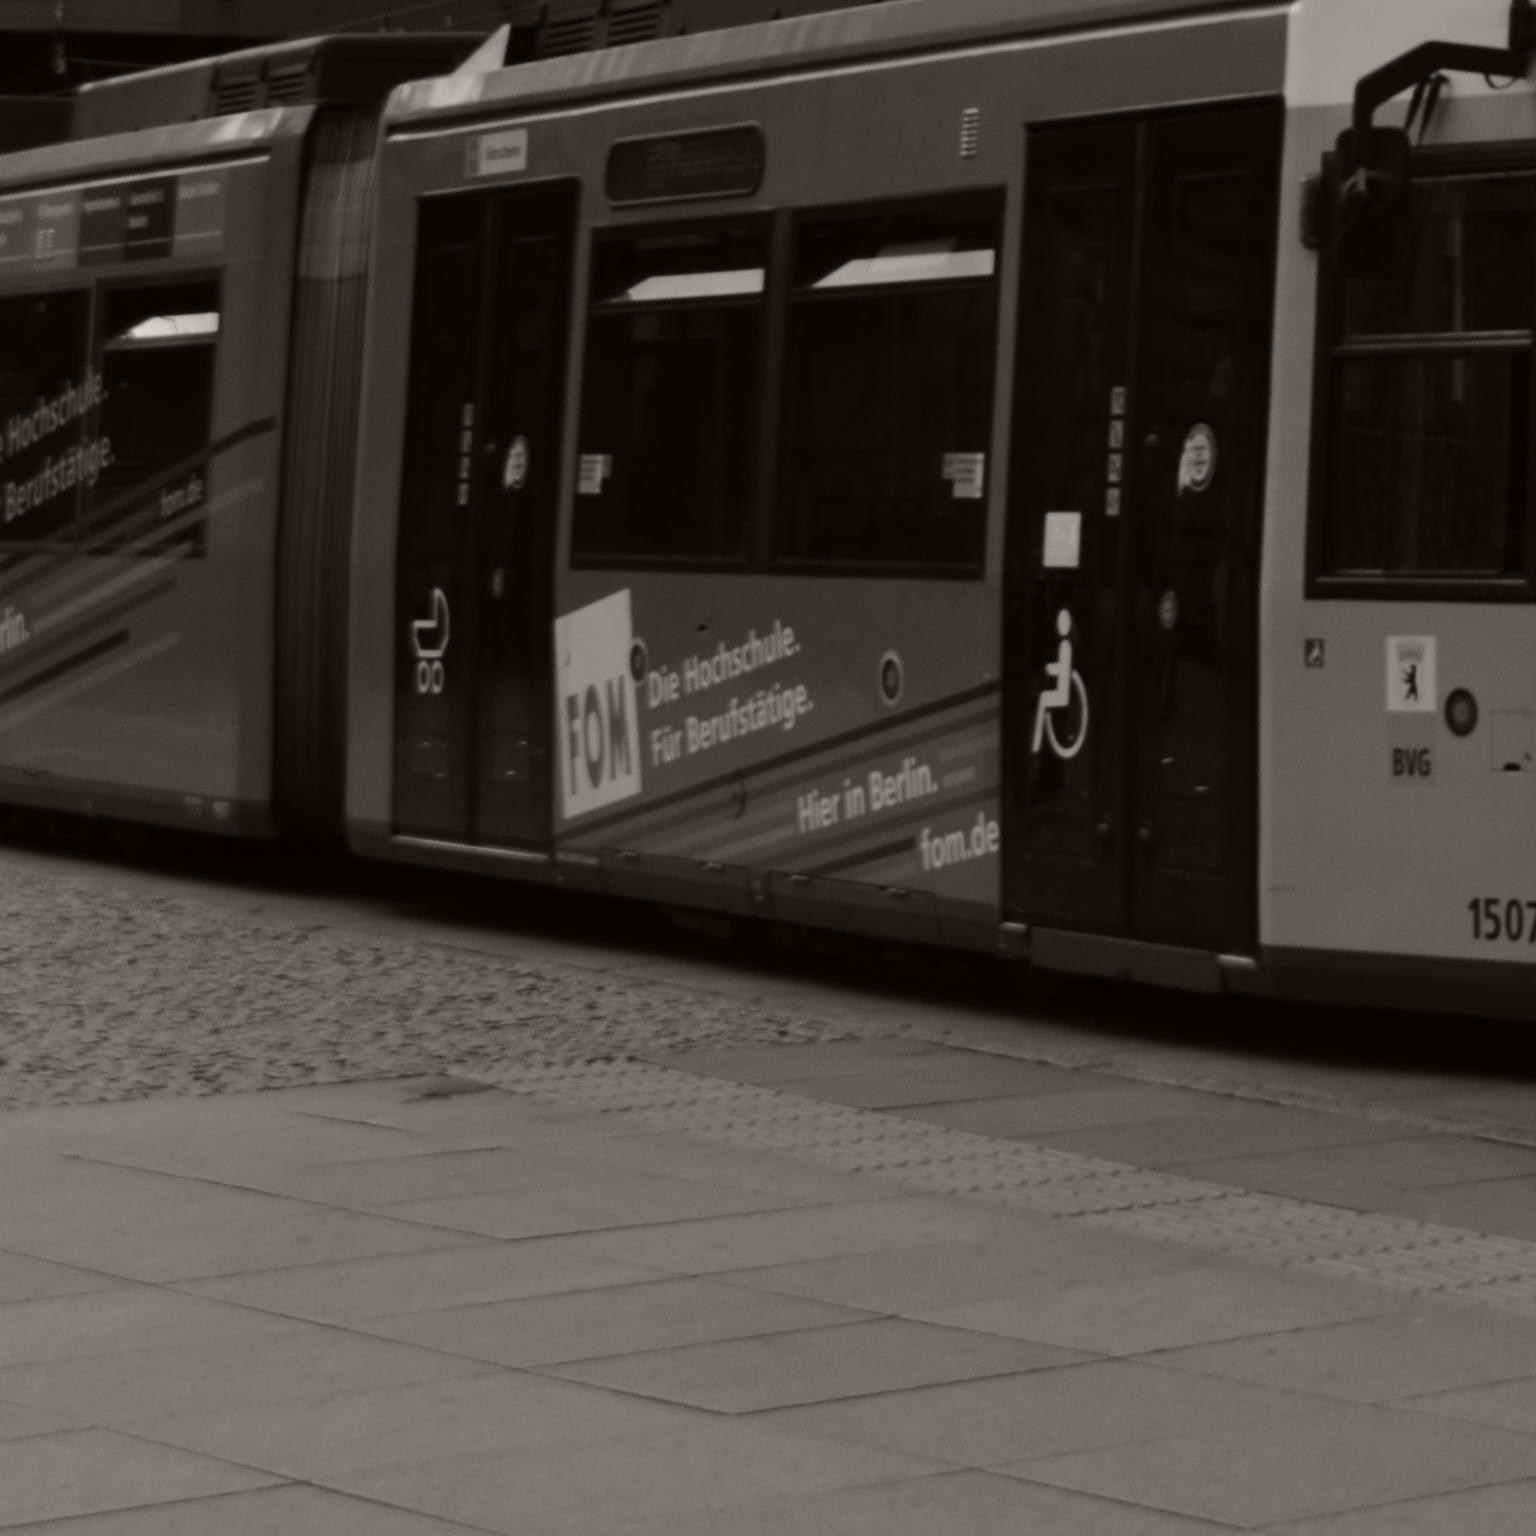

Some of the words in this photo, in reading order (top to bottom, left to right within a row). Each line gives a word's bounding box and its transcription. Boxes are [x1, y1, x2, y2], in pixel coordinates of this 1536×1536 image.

[646, 665, 680, 708] Die
[683, 619, 801, 694] Hochschule.
[565, 674, 633, 796] FOM
[650, 723, 683, 766] Für
[686, 682, 815, 754] Berufstätige.
[1391, 747, 1431, 777] BVG
[796, 789, 839, 833] Hier
[843, 778, 866, 820] in
[868, 756, 939, 812] Berlin.
[918, 811, 1000, 871] fom.de
